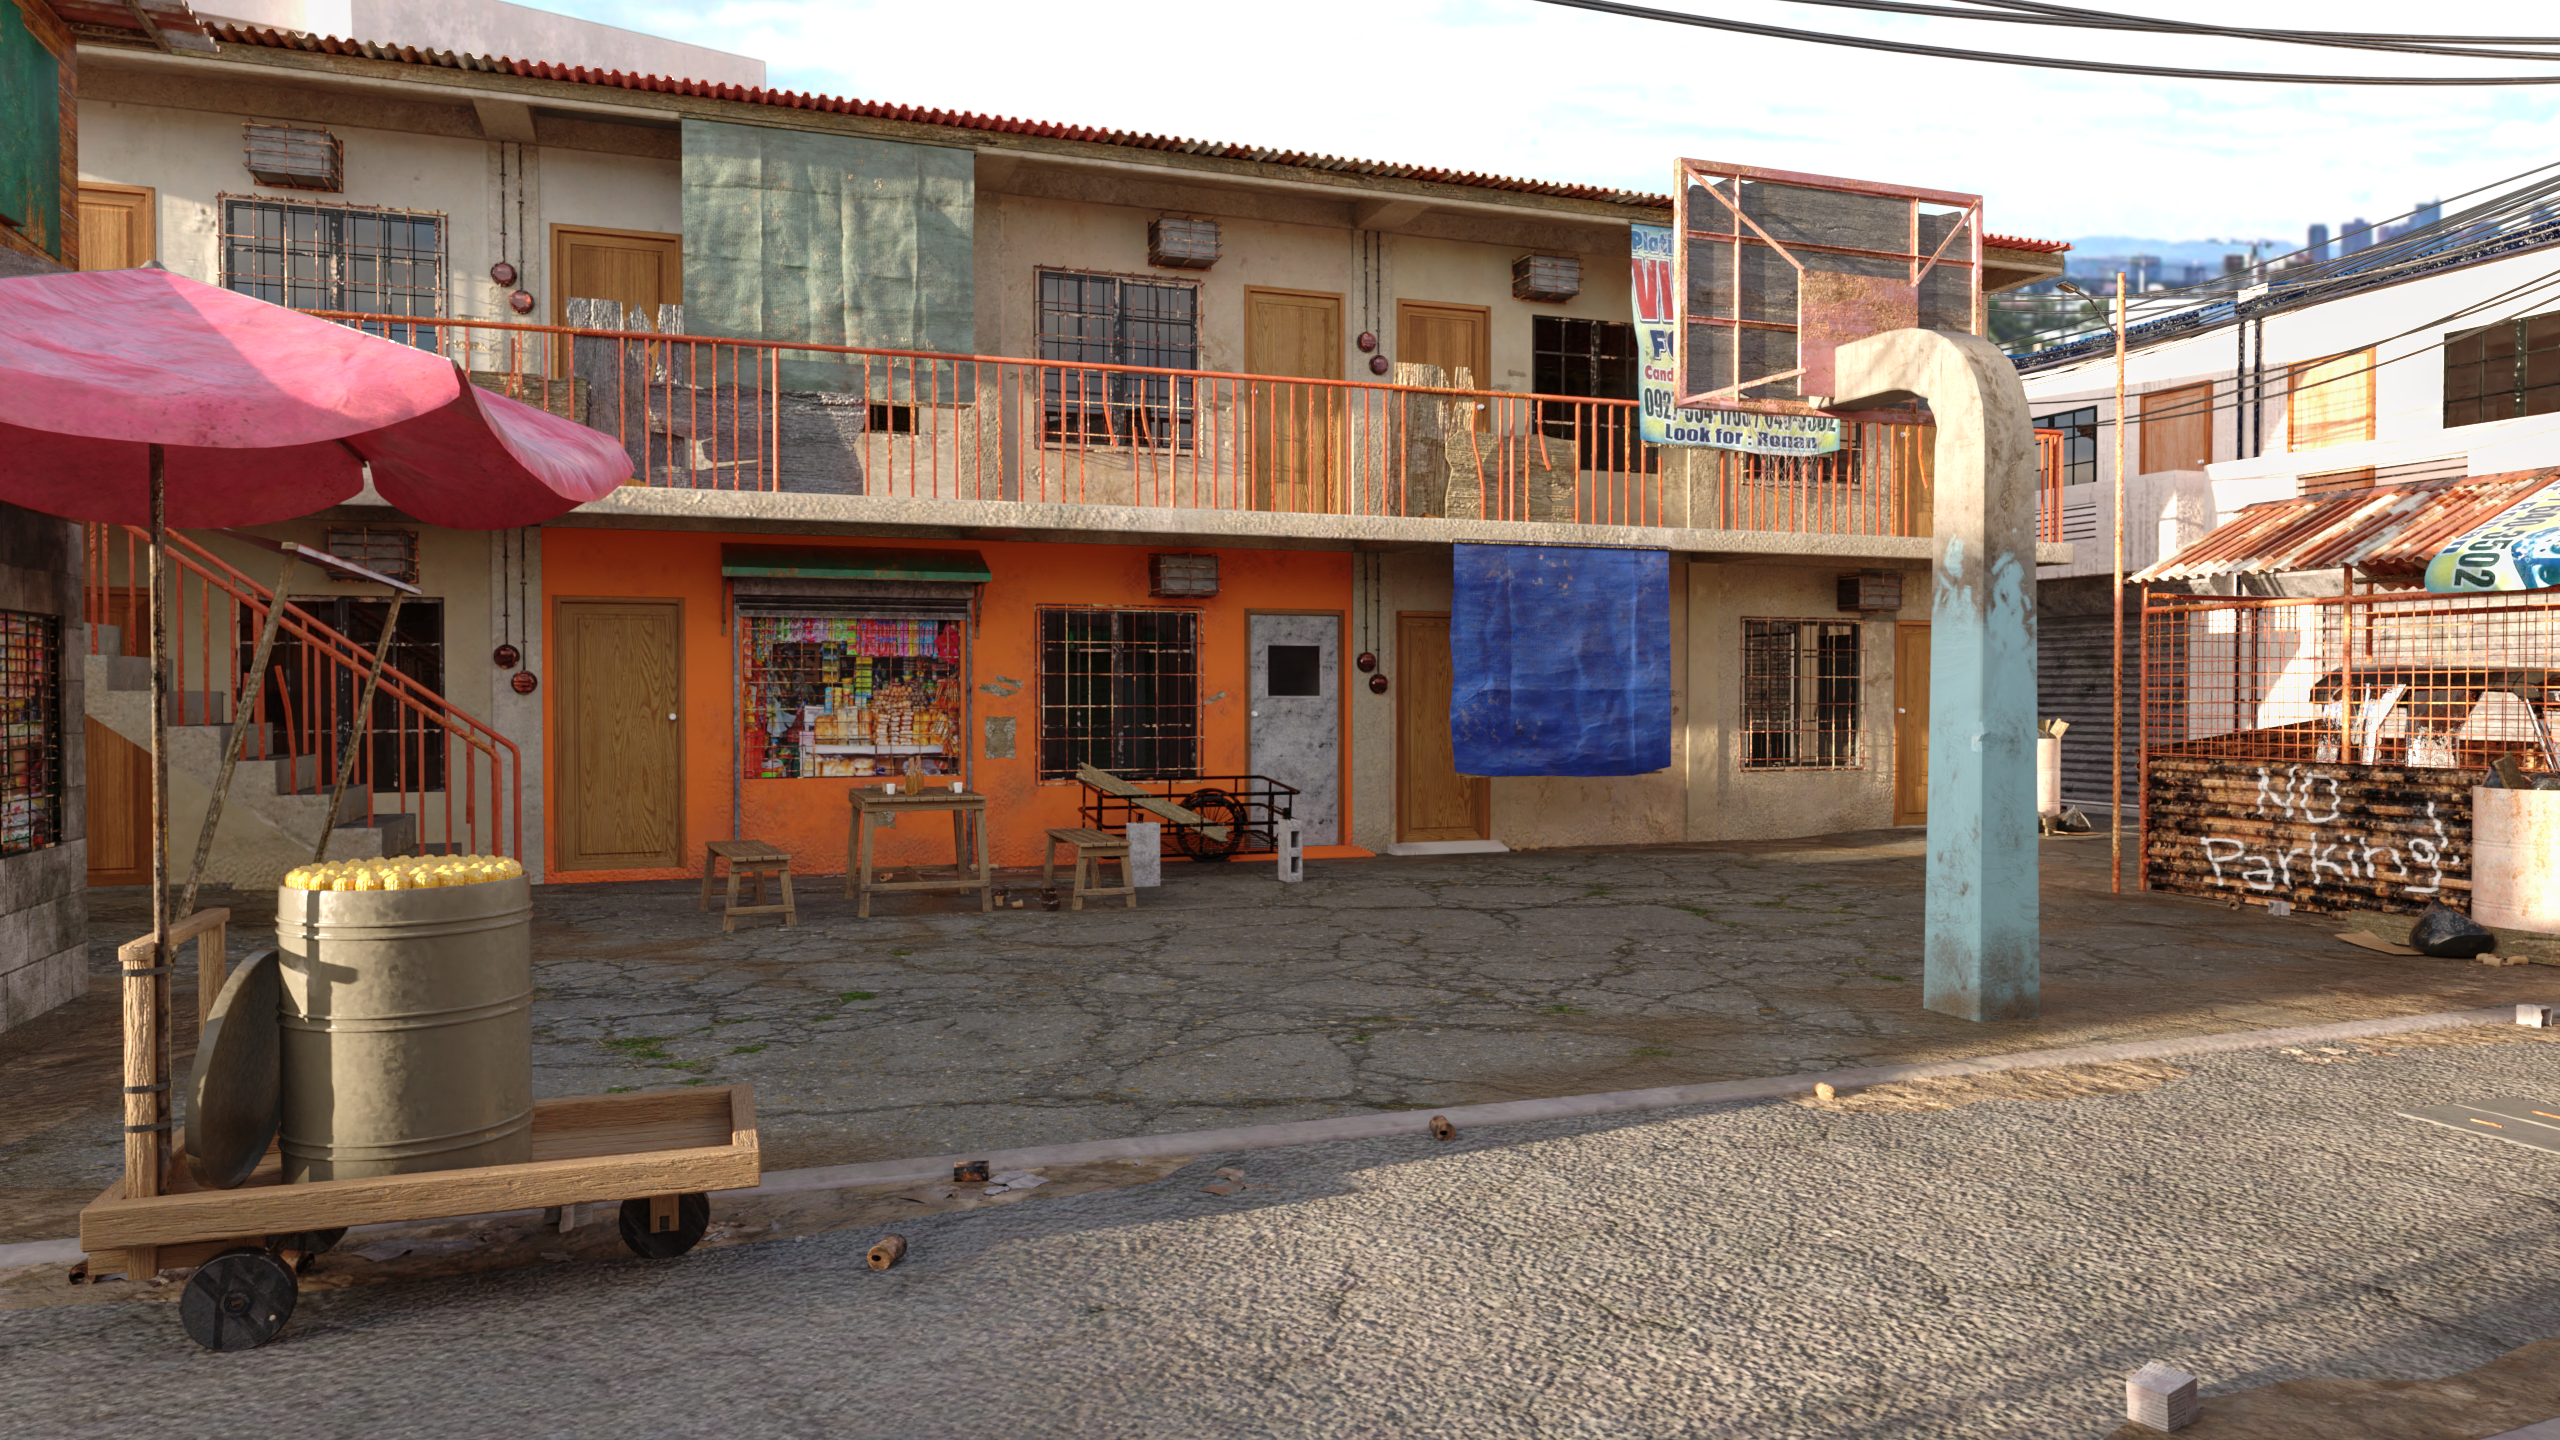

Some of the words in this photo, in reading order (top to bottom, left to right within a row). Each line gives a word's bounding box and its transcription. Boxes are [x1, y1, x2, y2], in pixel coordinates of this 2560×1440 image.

[1665, 423, 1711, 442] Look
[1716, 428, 1743, 445] for
[1757, 431, 1817, 449] Ronan
[2256, 765, 2341, 824] NO
